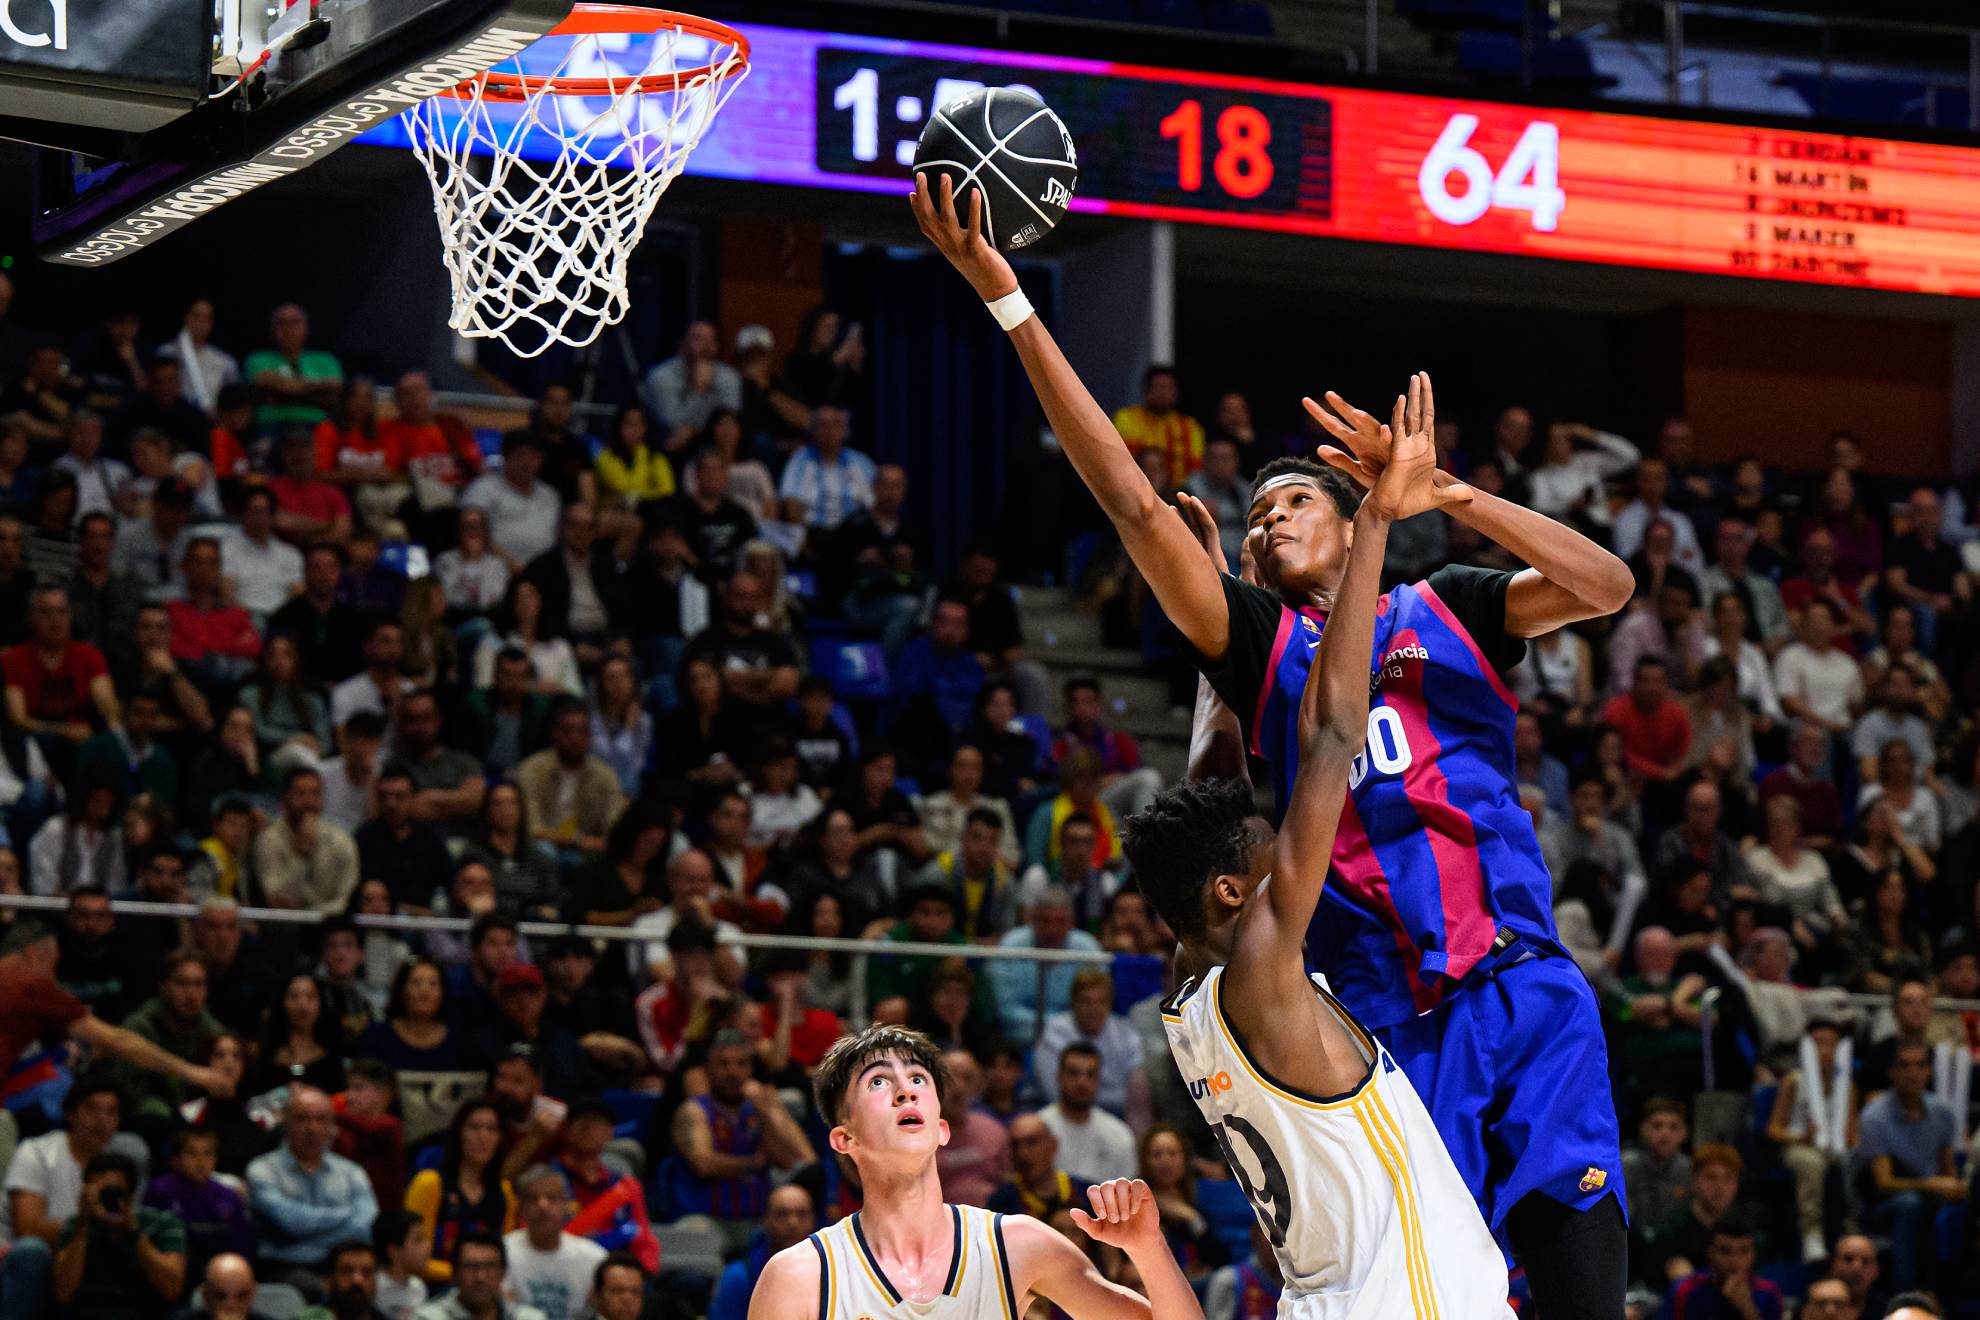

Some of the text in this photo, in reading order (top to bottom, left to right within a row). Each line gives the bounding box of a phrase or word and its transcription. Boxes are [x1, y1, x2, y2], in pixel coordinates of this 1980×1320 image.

[60, 27, 541, 263] MINICOPA endesa MINICOPA endesa
[1159, 100, 1274, 198] 18
[1419, 113, 1566, 232] 64
